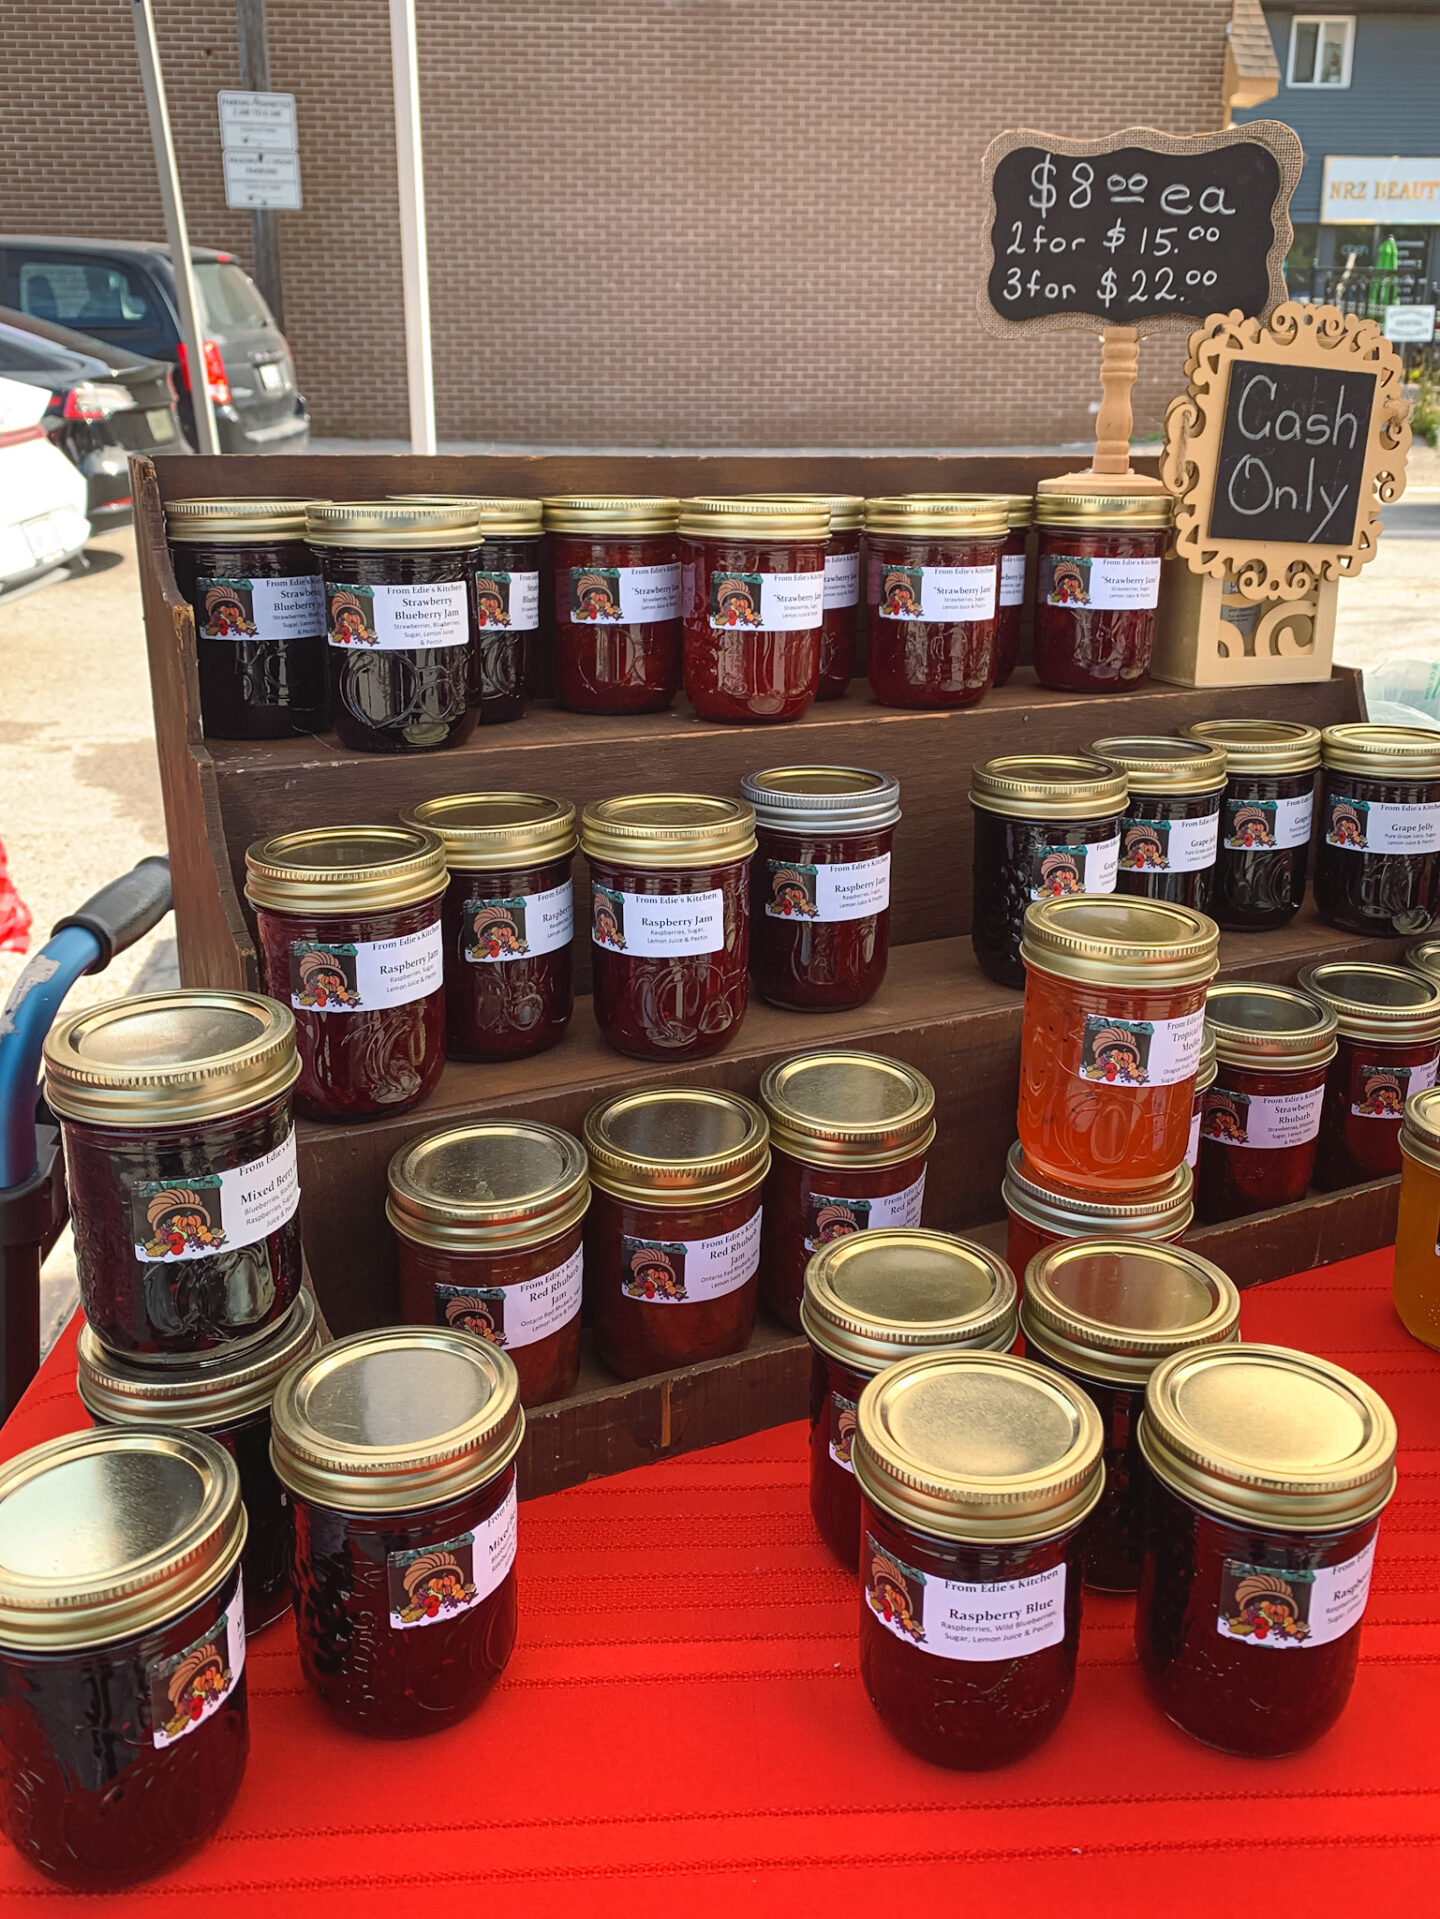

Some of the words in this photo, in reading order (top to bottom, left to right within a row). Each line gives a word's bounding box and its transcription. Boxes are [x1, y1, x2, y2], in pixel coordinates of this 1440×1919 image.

[1329, 181, 1367, 200] NRZ
[1160, 184, 1236, 215] ea
[1237, 374, 1358, 450] Cash
[1227, 453, 1349, 544] Only
[631, 568, 649, 576] From
[934, 567, 954, 575] From
[955, 567, 974, 575] Edie's
[266, 579, 288, 588] From
[774, 574, 792, 582] From
[386, 587, 411, 596] From
[412, 585, 436, 595] Edie's
[436, 583, 463, 593] Kitchen
[273, 602, 315, 612] Blueberry
[402, 598, 453, 607] Strawberry
[394, 611, 442, 621] Blueberry
[444, 609, 459, 619] Jam
[1286, 799, 1301, 807] From
[1181, 820, 1198, 829] From
[1391, 823, 1417, 832] Grape
[1418, 822, 1434, 832] Jelly
[1096, 840, 1110, 851] From
[1190, 838, 1209, 848] Grape
[829, 865, 850, 873] From
[851, 862, 870, 872] Edie's
[834, 882, 875, 894] Raspberry
[537, 891, 555, 902] From
[635, 896, 658, 904] From
[659, 896, 684, 905] Edie's
[686, 893, 717, 903] Kitchen
[641, 918, 693, 929] Raspberry
[694, 915, 713, 926] Jam
[372, 942, 397, 951] From
[399, 934, 421, 947] Edie's
[422, 923, 440, 940] Kitchen
[650, 929, 687, 937] Raspberries,
[647, 937, 667, 945] Lemon
[379, 957, 428, 976] Raspberry
[427, 948, 439, 963] Jam
[387, 983, 407, 993] Lemon
[1167, 1021, 1186, 1030] From
[1284, 1095, 1304, 1104] Edie's
[1274, 1102, 1315, 1114] Strawberry
[1278, 1112, 1311, 1125] Rhubarb
[239, 1160, 265, 1176] From
[266, 1145, 286, 1164] Edie's
[240, 1182, 274, 1206] Mixed
[276, 1168, 293, 1186] Berry
[884, 1195, 903, 1206] From
[890, 1202, 905, 1215] Red
[266, 1214, 281, 1228] Juice
[701, 1240, 724, 1250] From
[725, 1230, 745, 1244] Edie's
[710, 1248, 729, 1260] Red
[730, 1227, 758, 1253] Rhubarb
[730, 1253, 746, 1268] Jam
[519, 1280, 544, 1293] From
[544, 1269, 566, 1283] Edie's
[529, 1287, 549, 1302] Red
[551, 1264, 580, 1294] Rhubarb
[700, 1273, 723, 1283] Ontario
[711, 1279, 730, 1289] Lemon
[551, 1291, 567, 1307] Jam
[520, 1314, 544, 1328] Ontario
[544, 1308, 555, 1319] Red
[532, 1320, 551, 1333] Lemon
[486, 1506, 506, 1528] From
[1332, 1559, 1356, 1576] From
[944, 1580, 977, 1593] From
[980, 1581, 1016, 1594] Edie's
[1017, 1568, 1059, 1589] Kitchen
[949, 1607, 1023, 1624] Raspberry
[1025, 1597, 1054, 1615] Blue
[941, 1620, 993, 1634] Raspberries,
[995, 1621, 1015, 1631] Wild
[1015, 1609, 1058, 1629] Blueberries,
[944, 1631, 971, 1643] Sugar,
[972, 1633, 1001, 1643] Lemon
[1002, 1630, 1024, 1642] Juice
[1024, 1628, 1031, 1636] &
[1032, 1619, 1055, 1634] Pectin
